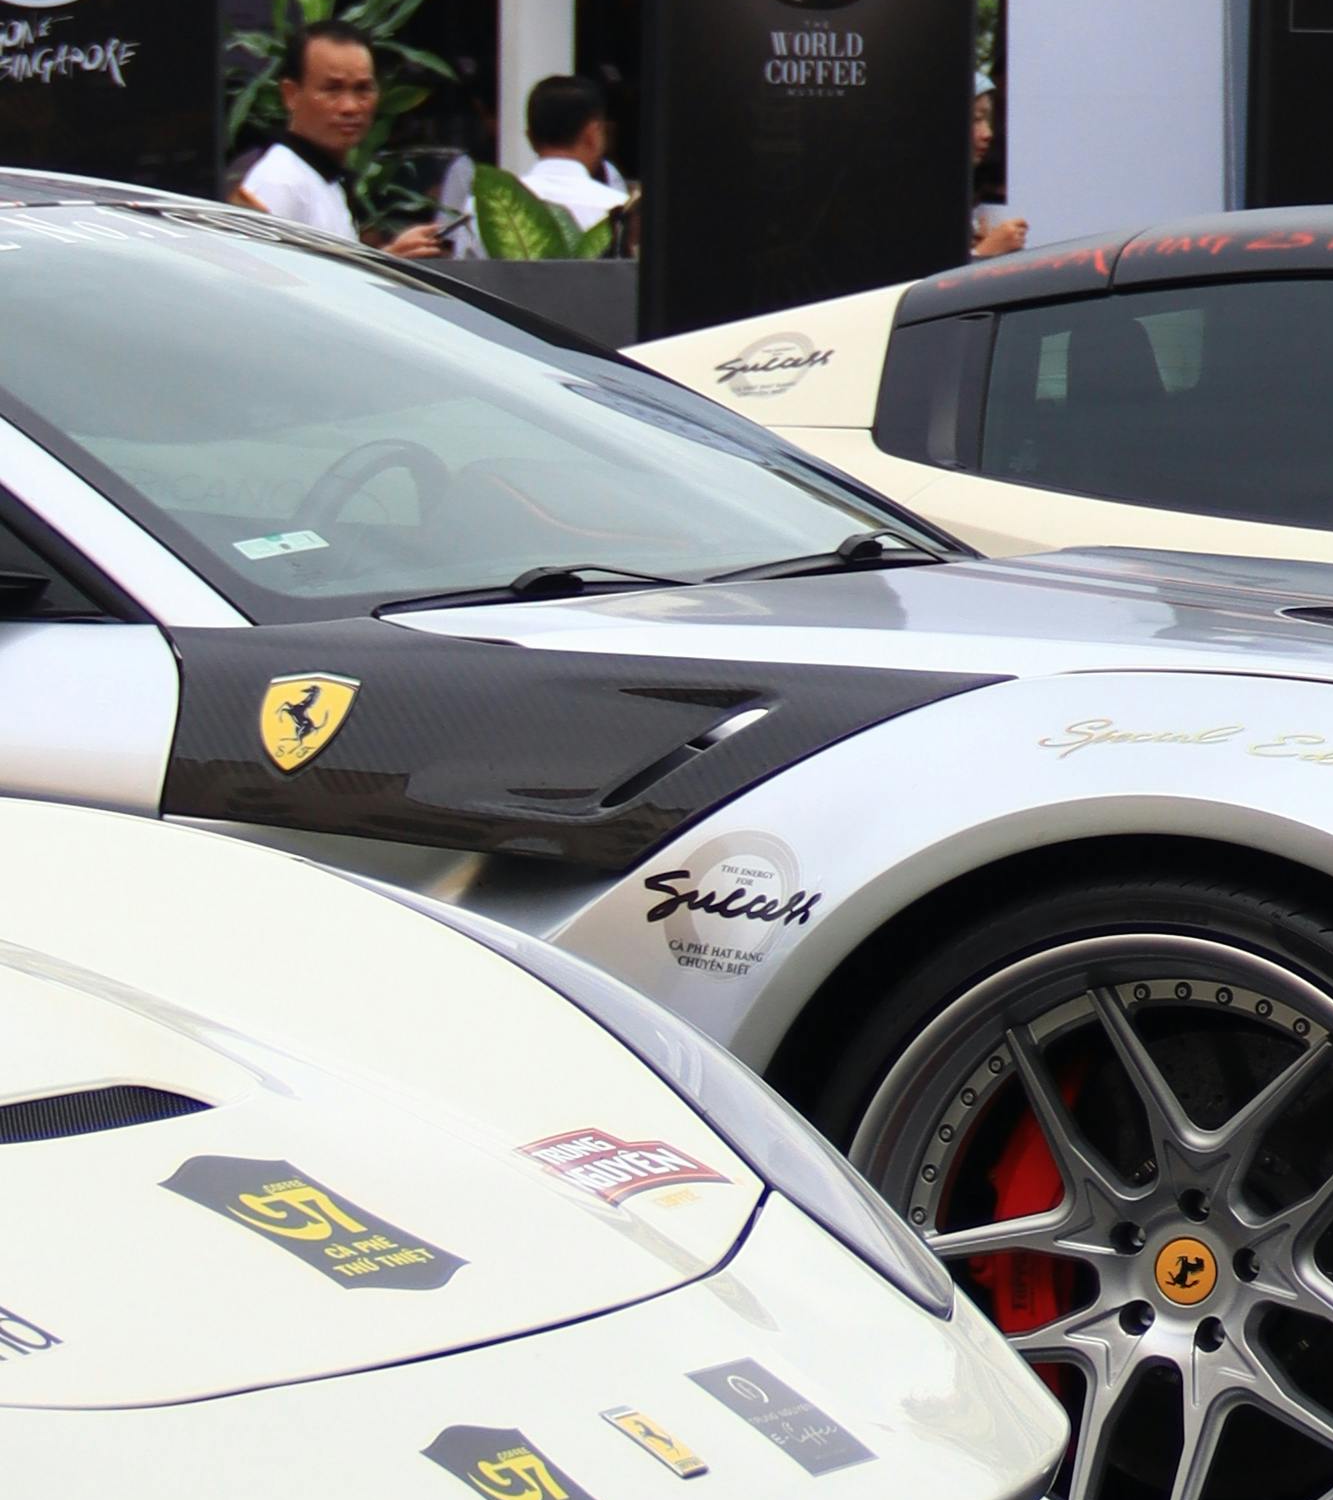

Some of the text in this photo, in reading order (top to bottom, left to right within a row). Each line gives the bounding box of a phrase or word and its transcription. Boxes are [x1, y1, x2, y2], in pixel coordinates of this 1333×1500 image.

[770, 31, 864, 57] WORLD
[765, 59, 867, 86] COFFEE
[1038, 719, 1244, 759] Special
[720, 864, 775, 880] THE ENERGY
[736, 877, 754, 887] FOR
[644, 870, 822, 926] Success
[735, 950, 763, 963] RANG
[531, 1136, 616, 1165] TRUNG
[564, 1148, 698, 1191] NGUYÊN
[262, 1178, 306, 1194] COFFEE
[226, 1186, 368, 1240] G7
[324, 1234, 399, 1260] CÀ PHÊ
[375, 1247, 435, 1270] THIỆT
